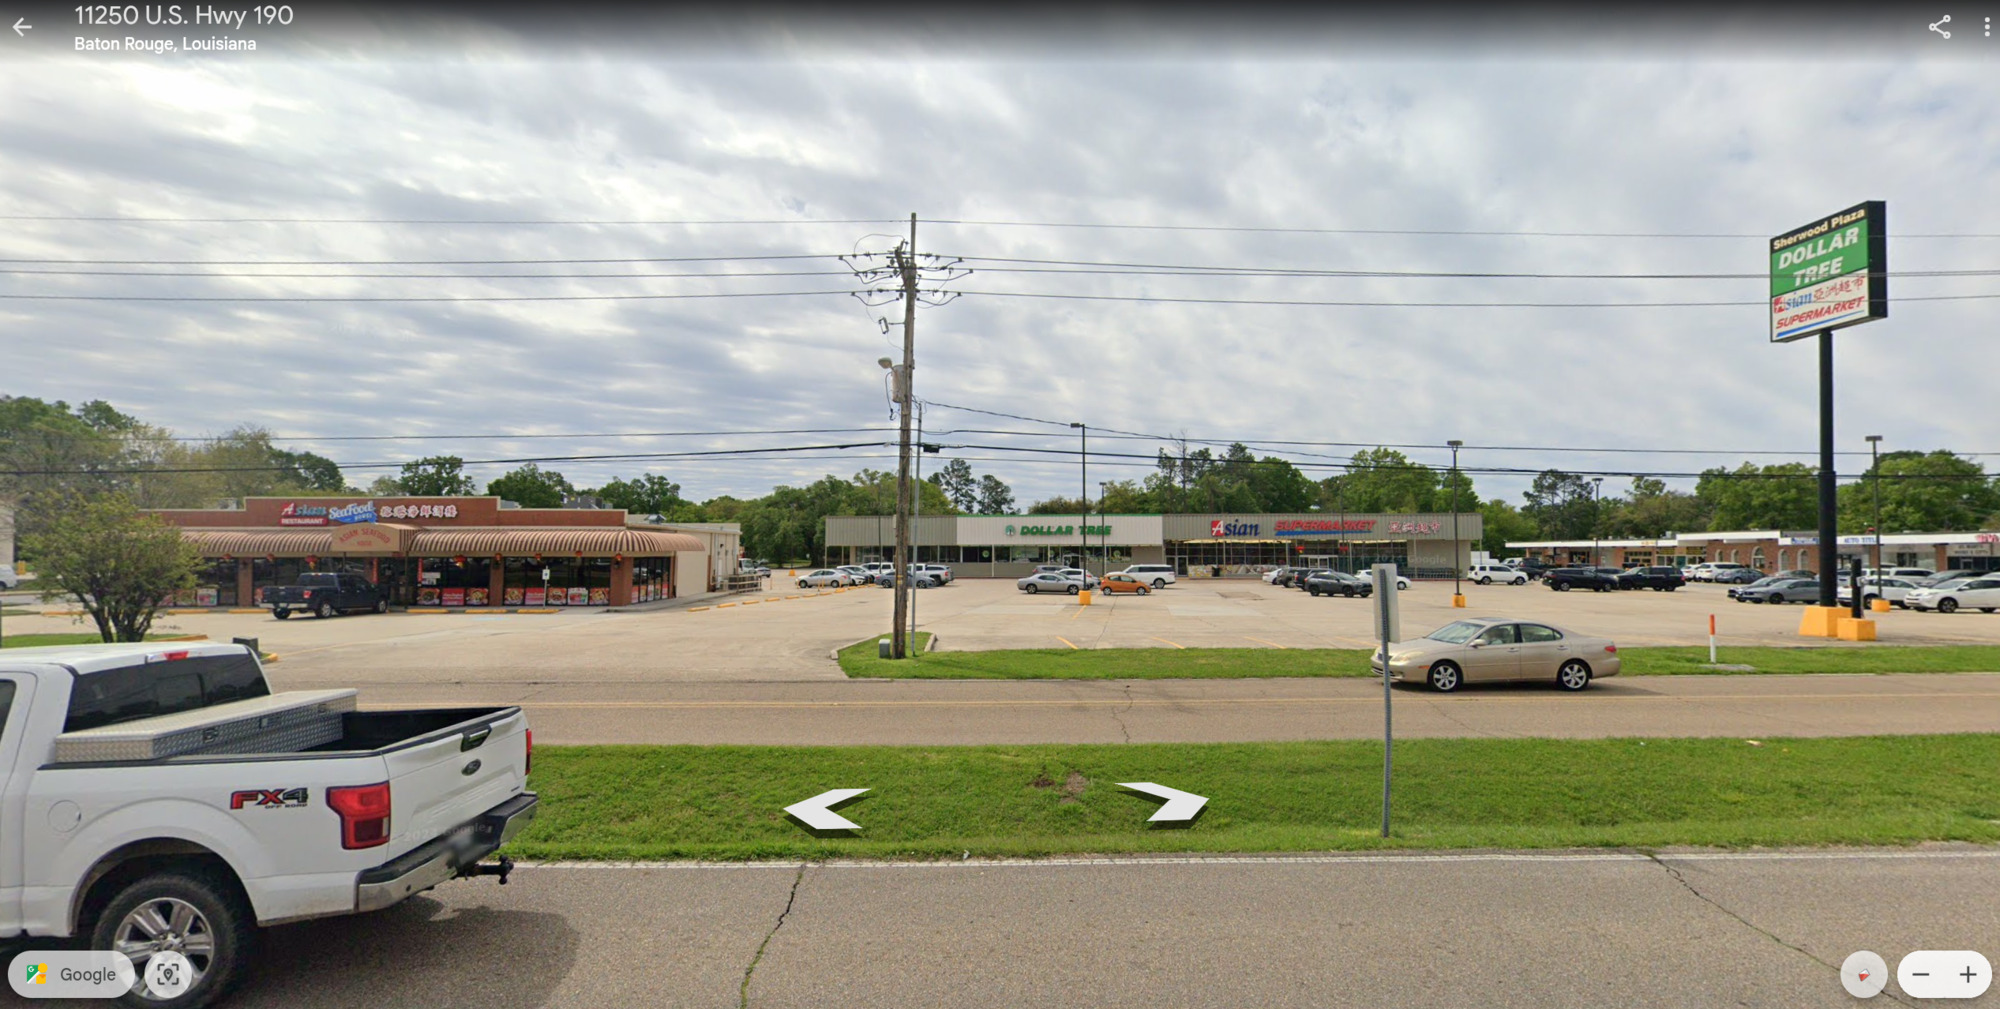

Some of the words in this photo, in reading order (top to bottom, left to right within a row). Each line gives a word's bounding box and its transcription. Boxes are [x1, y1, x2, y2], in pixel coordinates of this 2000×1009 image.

[1773, 221, 1828, 250] Sherwood
[1831, 209, 1865, 228] Plaza
[1778, 227, 1859, 270] DOLLAR
[1793, 256, 1844, 287] TREE
[1773, 291, 1813, 314] Asian
[1776, 296, 1865, 329] SUPERMARKET
[281, 502, 327, 516] Asian
[1020, 525, 1074, 536] DOLLAR
[1079, 525, 1113, 536] TREE
[1211, 519, 1260, 537] Asian
[1274, 520, 1376, 531] SUPERMARKET
[230, 787, 308, 809] FX4
